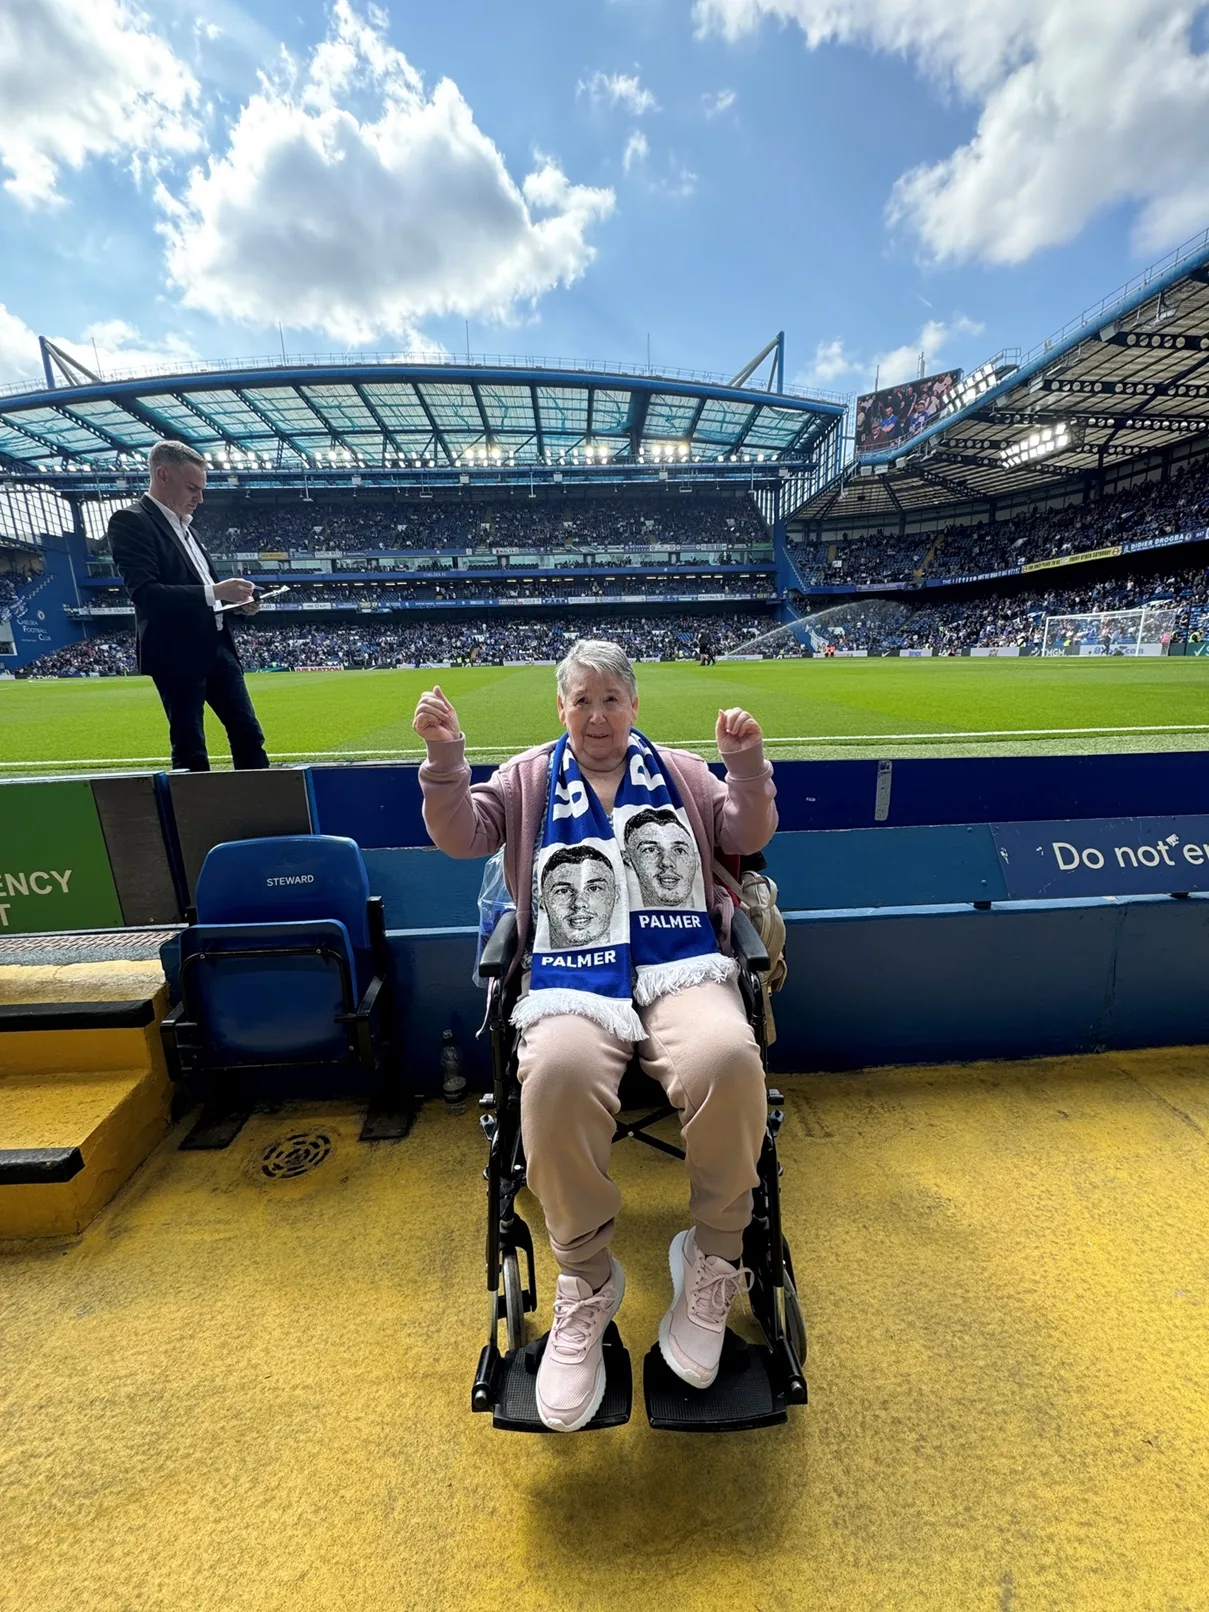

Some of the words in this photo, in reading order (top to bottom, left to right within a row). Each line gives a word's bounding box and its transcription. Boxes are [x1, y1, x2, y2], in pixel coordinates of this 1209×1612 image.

[1130, 540, 1153, 550] DIDIER
[1154, 533, 1184, 545] DROGBA
[1051, 842, 1105, 871] Do
[1114, 840, 1176, 868] not
[1182, 843, 1209, 866] e
[266, 874, 315, 887] STEWARD
[638, 914, 702, 929] PALMER
[541, 949, 617, 968] PALMER
